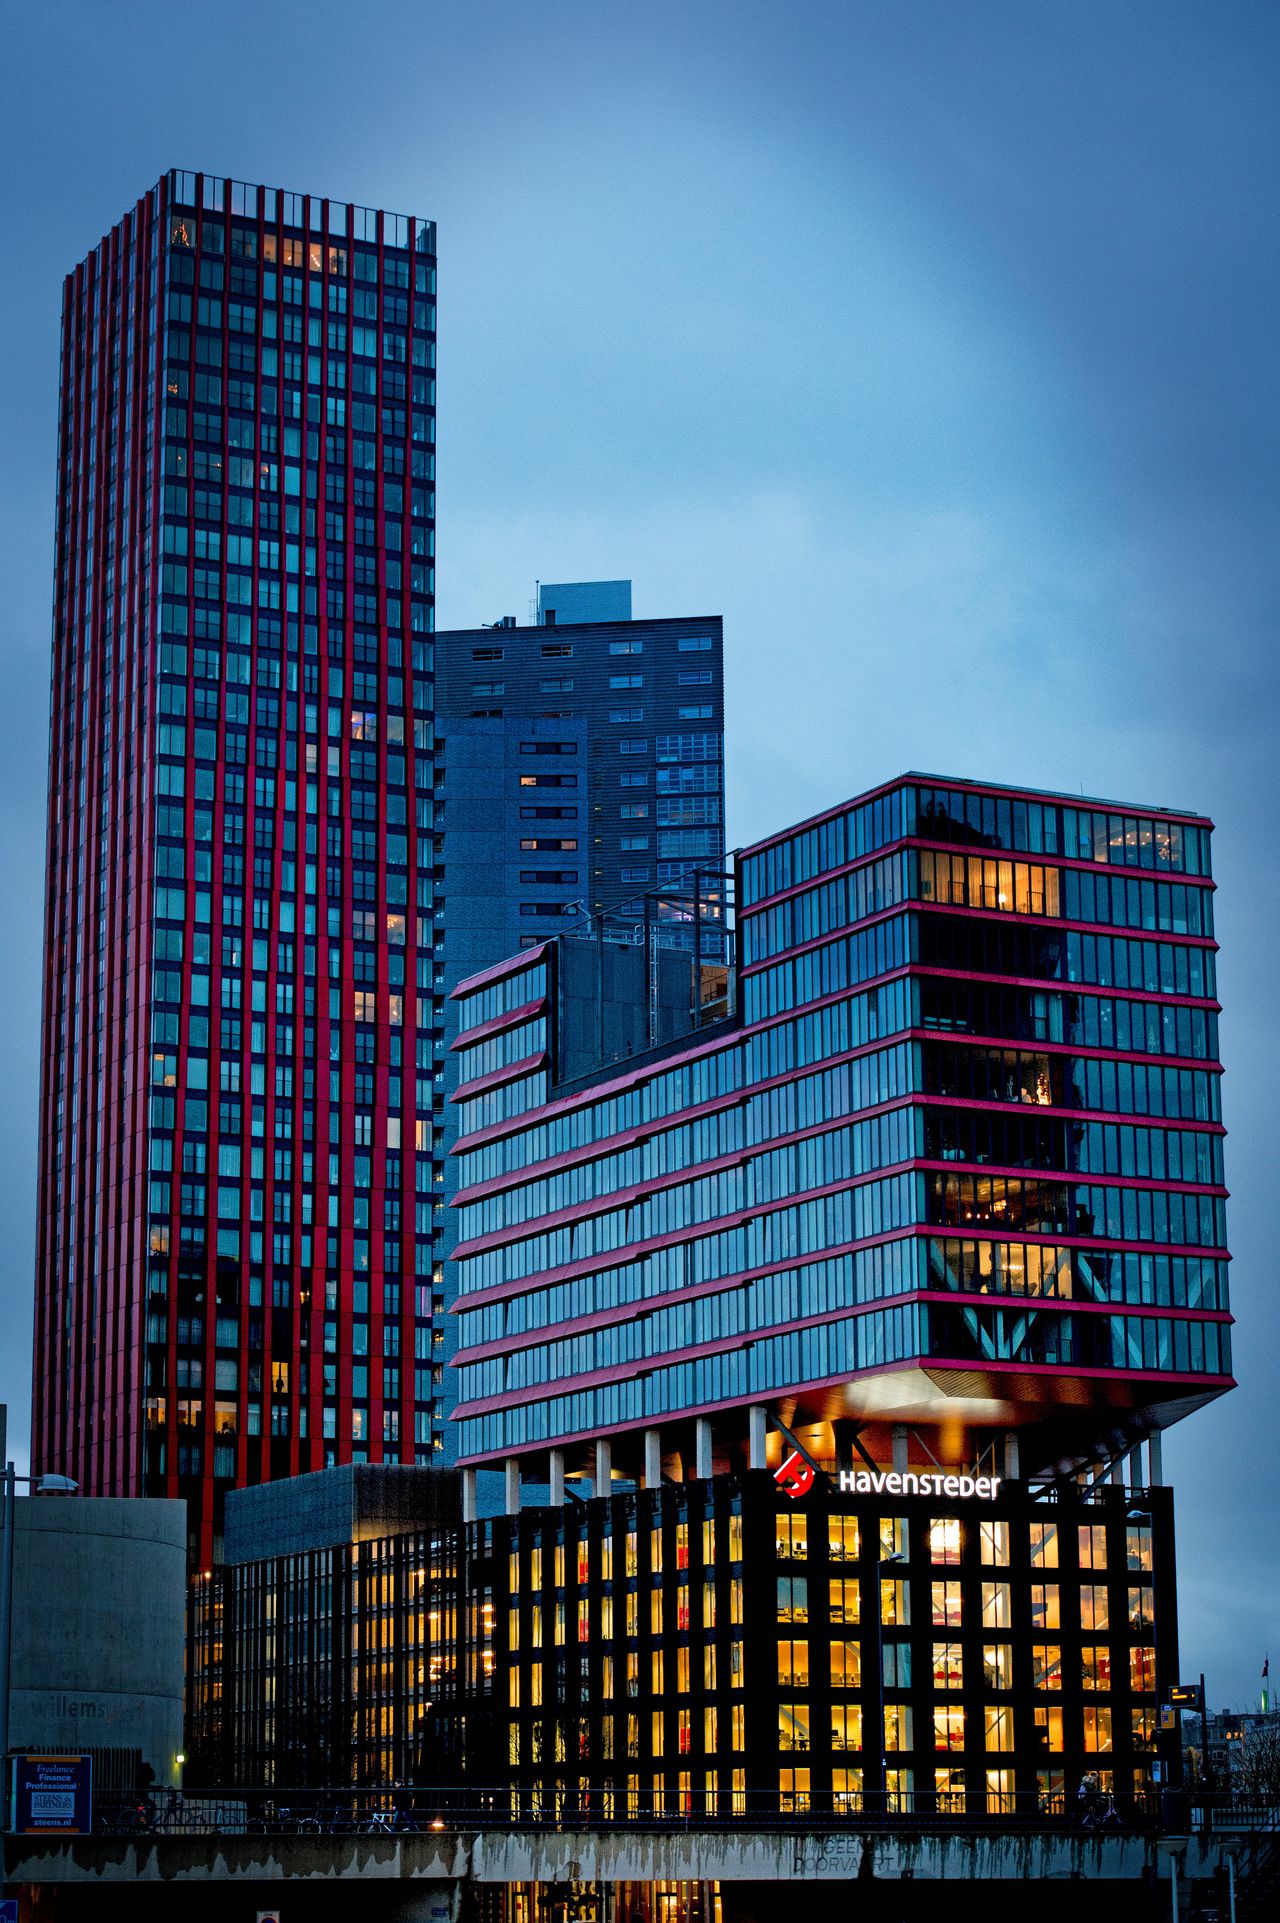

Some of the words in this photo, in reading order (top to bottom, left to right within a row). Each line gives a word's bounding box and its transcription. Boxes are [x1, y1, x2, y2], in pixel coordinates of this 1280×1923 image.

[36, 1764, 75, 1773] Freelance
[39, 1774, 71, 1782] Finance
[34, 1794, 63, 1802] STEENS
[34, 1801, 72, 1809] PARTNERS
[793, 1857, 894, 1872] DOORVART
